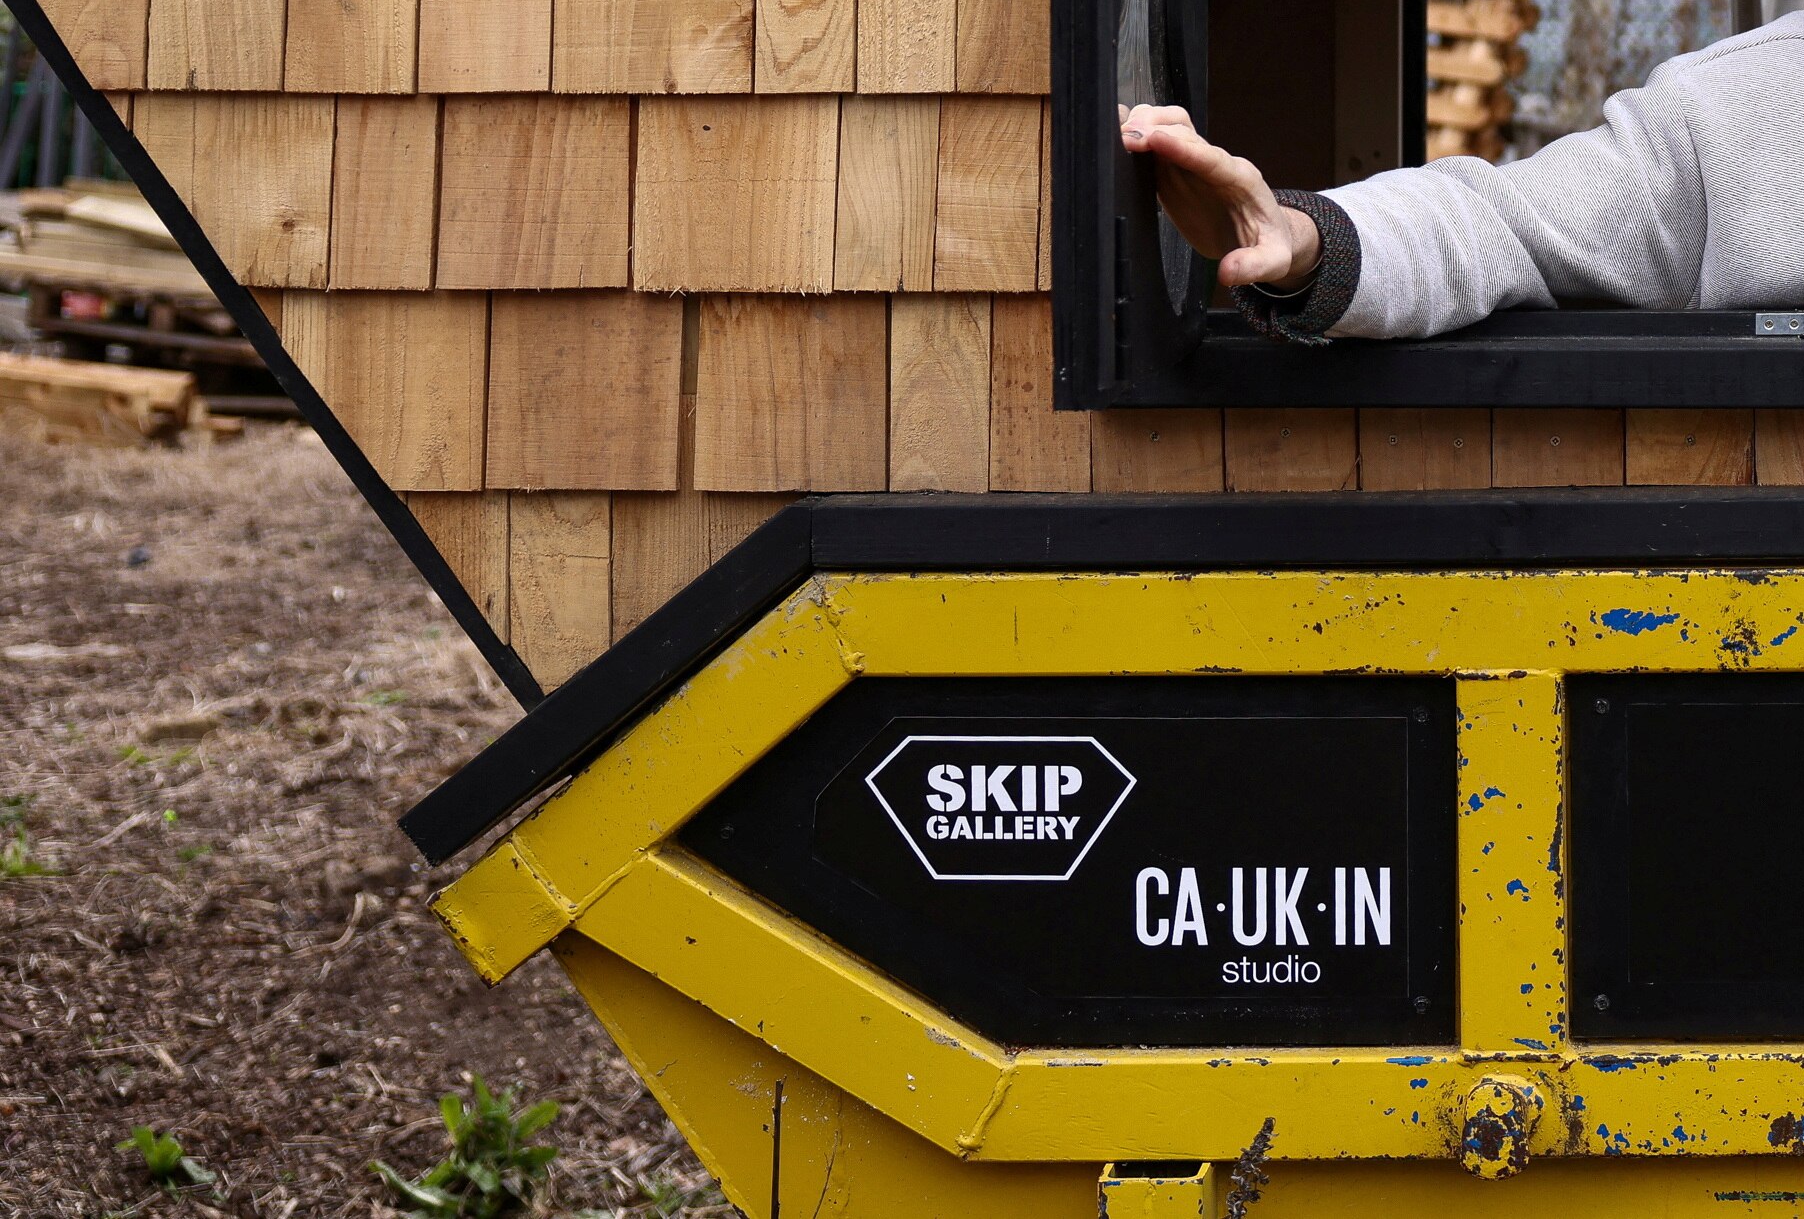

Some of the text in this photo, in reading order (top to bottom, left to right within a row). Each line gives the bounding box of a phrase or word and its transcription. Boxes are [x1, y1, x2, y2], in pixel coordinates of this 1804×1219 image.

[925, 764, 1083, 812] SKIP
[926, 815, 1081, 840] GALLERY
[1222, 954, 1321, 984] studio
